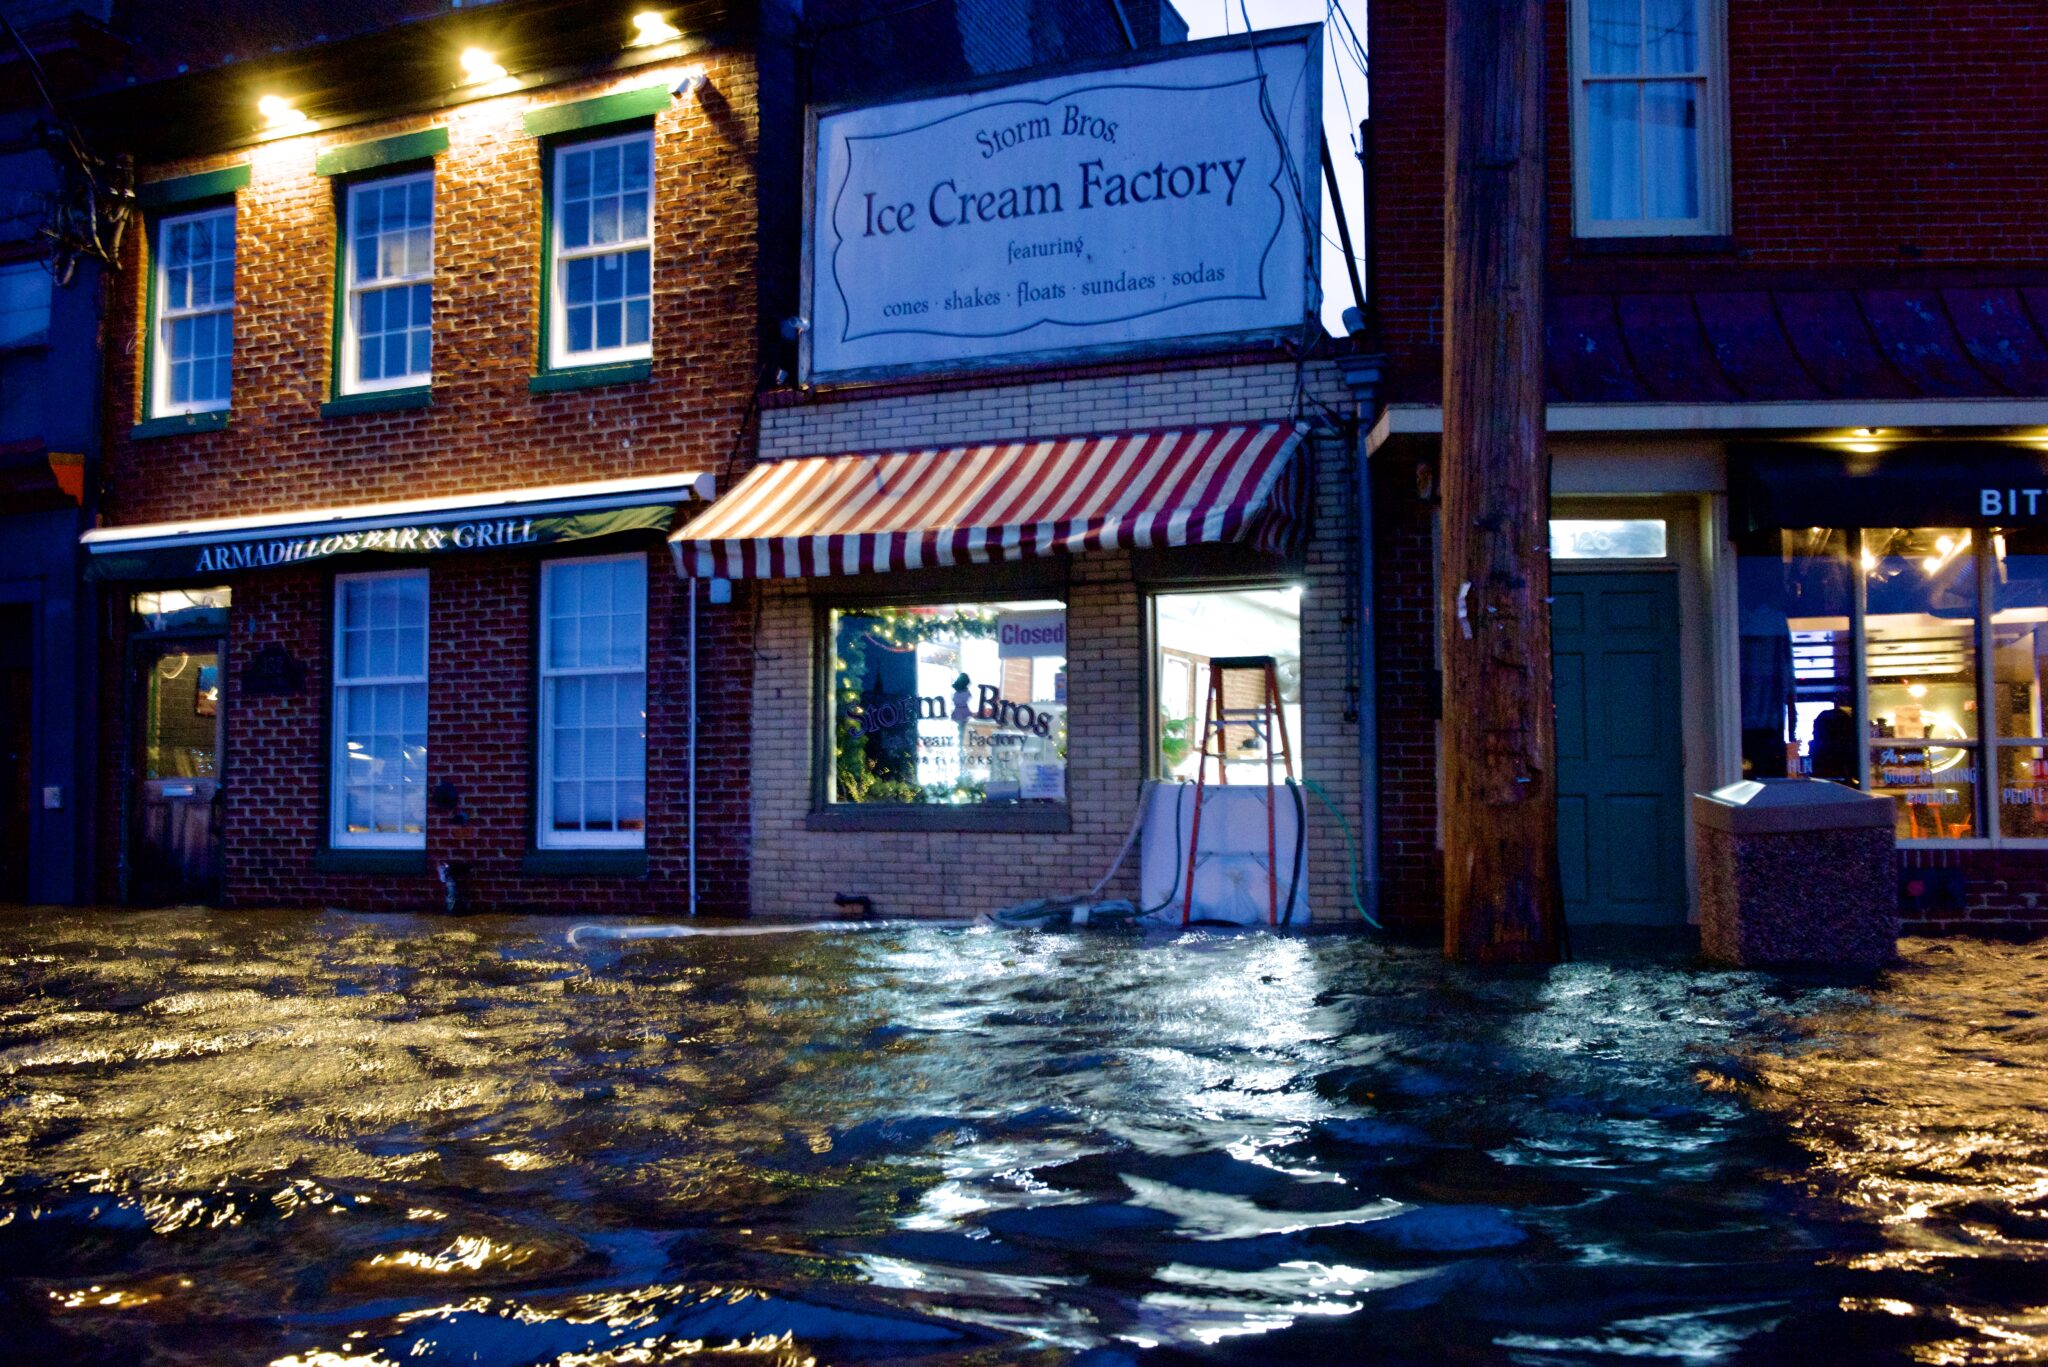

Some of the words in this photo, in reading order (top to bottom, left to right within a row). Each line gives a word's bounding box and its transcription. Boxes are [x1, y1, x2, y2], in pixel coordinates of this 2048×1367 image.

[975, 116, 1051, 160] Storm
[1061, 104, 1119, 144] Bros.
[862, 191, 916, 237] Ice
[928, 178, 1064, 228] Cream
[1078, 157, 1247, 210] Factory
[1007, 236, 1085, 264] featuring
[882, 299, 930, 319] cones
[943, 287, 1001, 312] shakes
[1016, 280, 1067, 307] floats
[1081, 271, 1156, 296] sundaes
[1171, 262, 1226, 286] sodas
[1981, 488, 2048, 517] BIT
[361, 526, 419, 549] BAR
[421, 526, 448, 549] &
[452, 518, 538, 549] GRILL
[1001, 622, 1066, 647] Closed
[846, 694, 948, 738] Storm
[977, 683, 1055, 741] Bros.
[968, 729, 1028, 751] Factory
